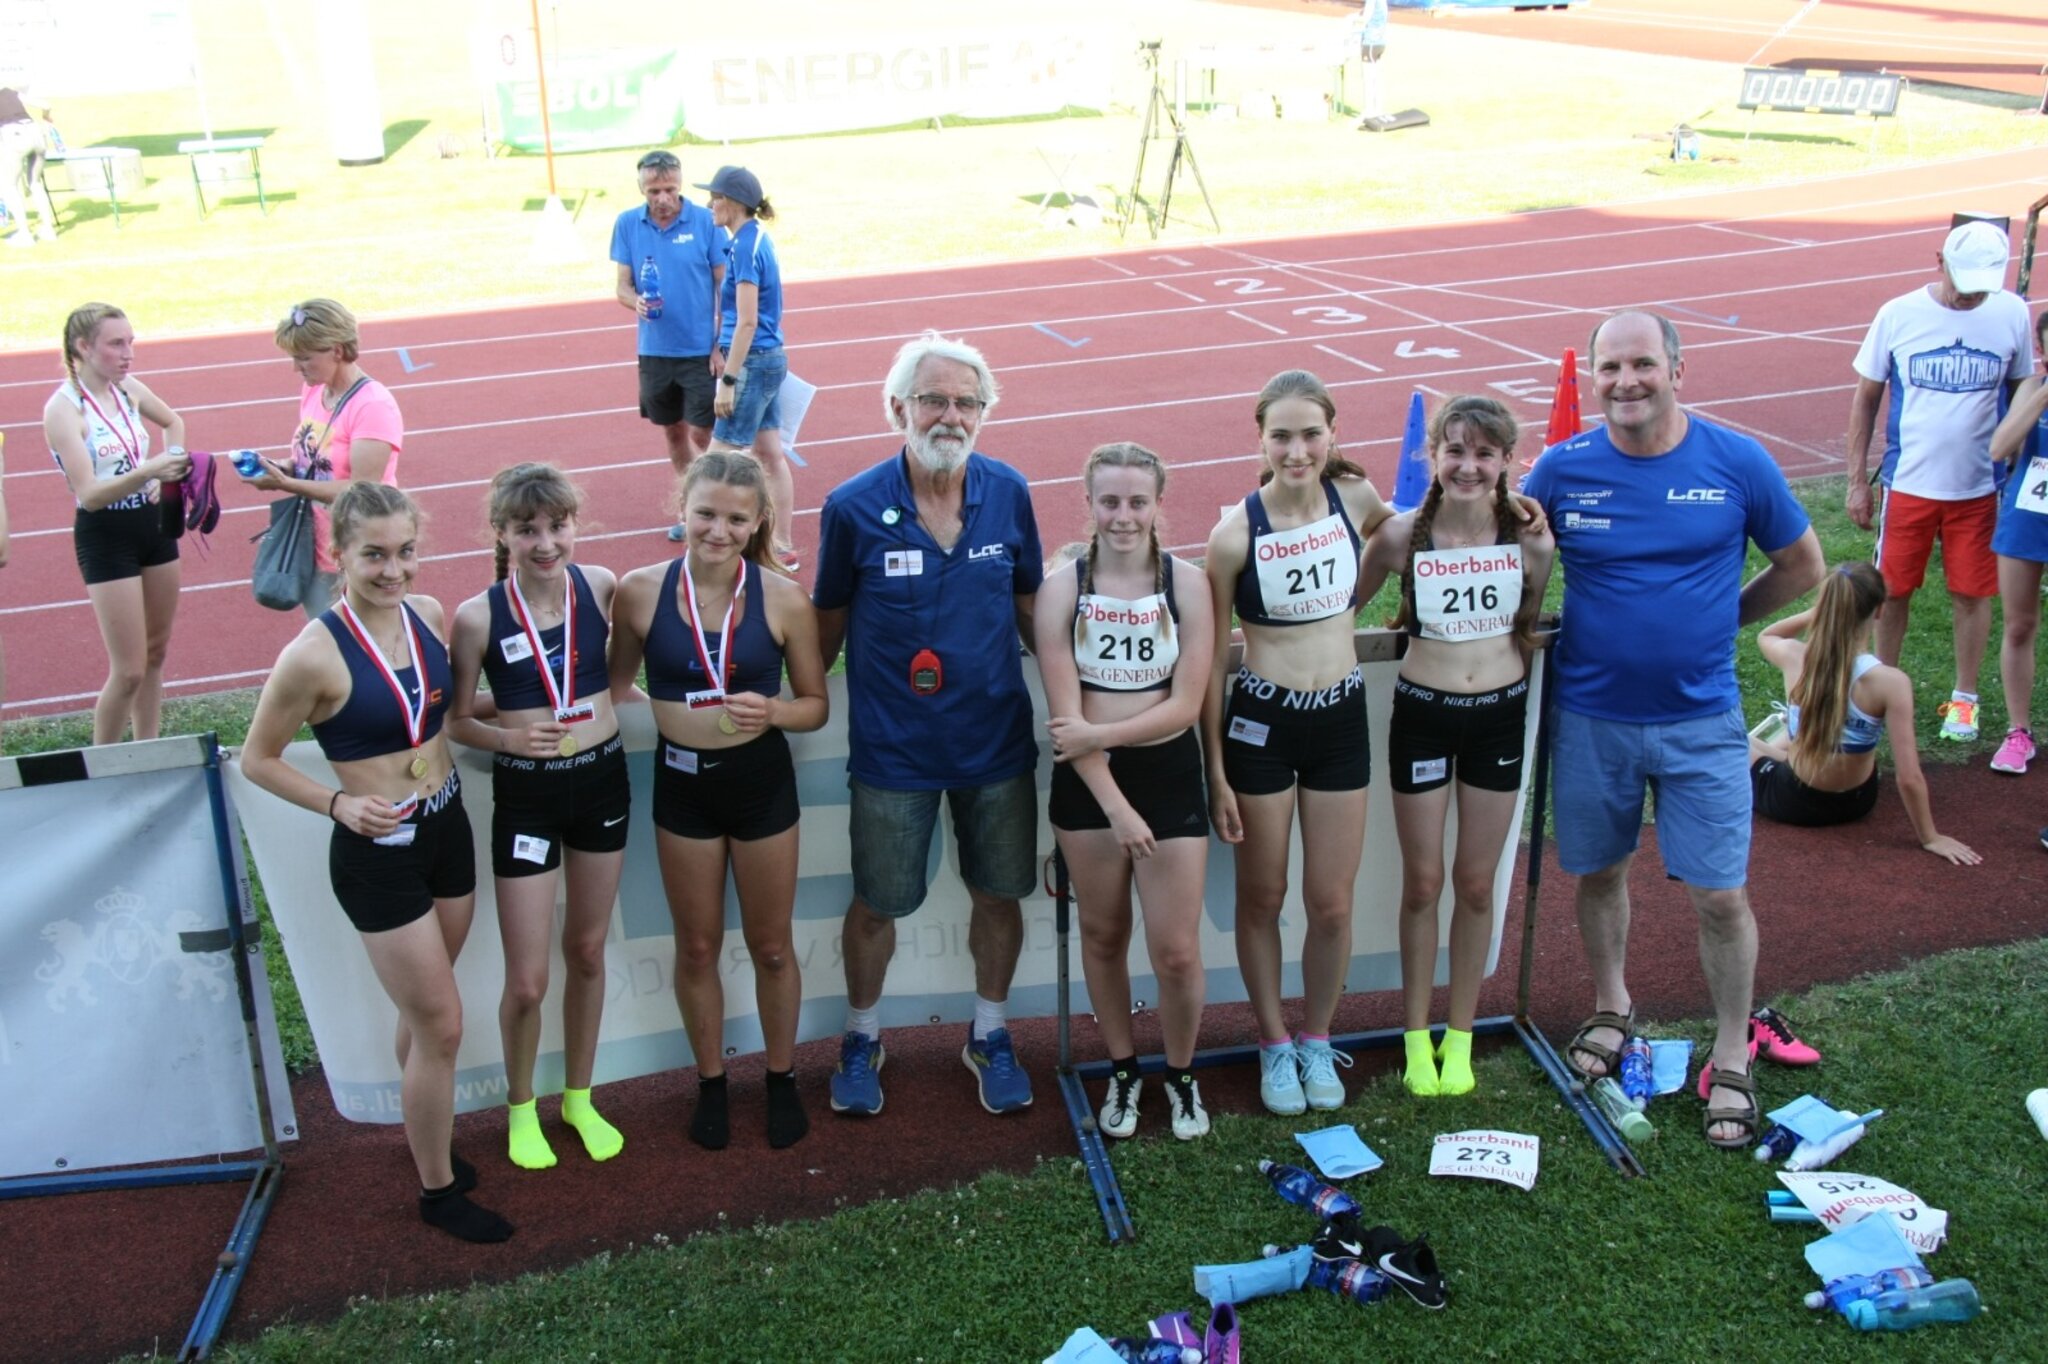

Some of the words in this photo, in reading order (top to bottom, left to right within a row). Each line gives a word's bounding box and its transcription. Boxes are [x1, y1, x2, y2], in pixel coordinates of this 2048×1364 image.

[712, 42, 990, 106] ENERGIE
[1213, 277, 1286, 295] 2
[1292, 306, 1368, 325] 3
[1393, 340, 1462, 360] 4
[1258, 524, 1348, 561] Oberbank
[1286, 557, 1336, 595] 217
[1416, 553, 1519, 577] Oberbank
[1442, 584, 1498, 614] 216
[1098, 634, 1154, 662] 218
[1238, 666, 1277, 700] PRO
[1282, 682, 1341, 710] NIKE
[1344, 666, 1363, 697] PR
[1408, 687, 1434, 701] PRO
[1443, 696, 1474, 707] NIKE
[1475, 693, 1499, 706] PRO
[1507, 680, 1527, 698] NIKE
[510, 759, 535, 770] PRO
[545, 758, 574, 770] NIKE
[575, 751, 597, 767] PRO
[423, 767, 461, 817] NIKE
[1456, 1147, 1512, 1165] 273
[1820, 1193, 1916, 1224] Oberbank
